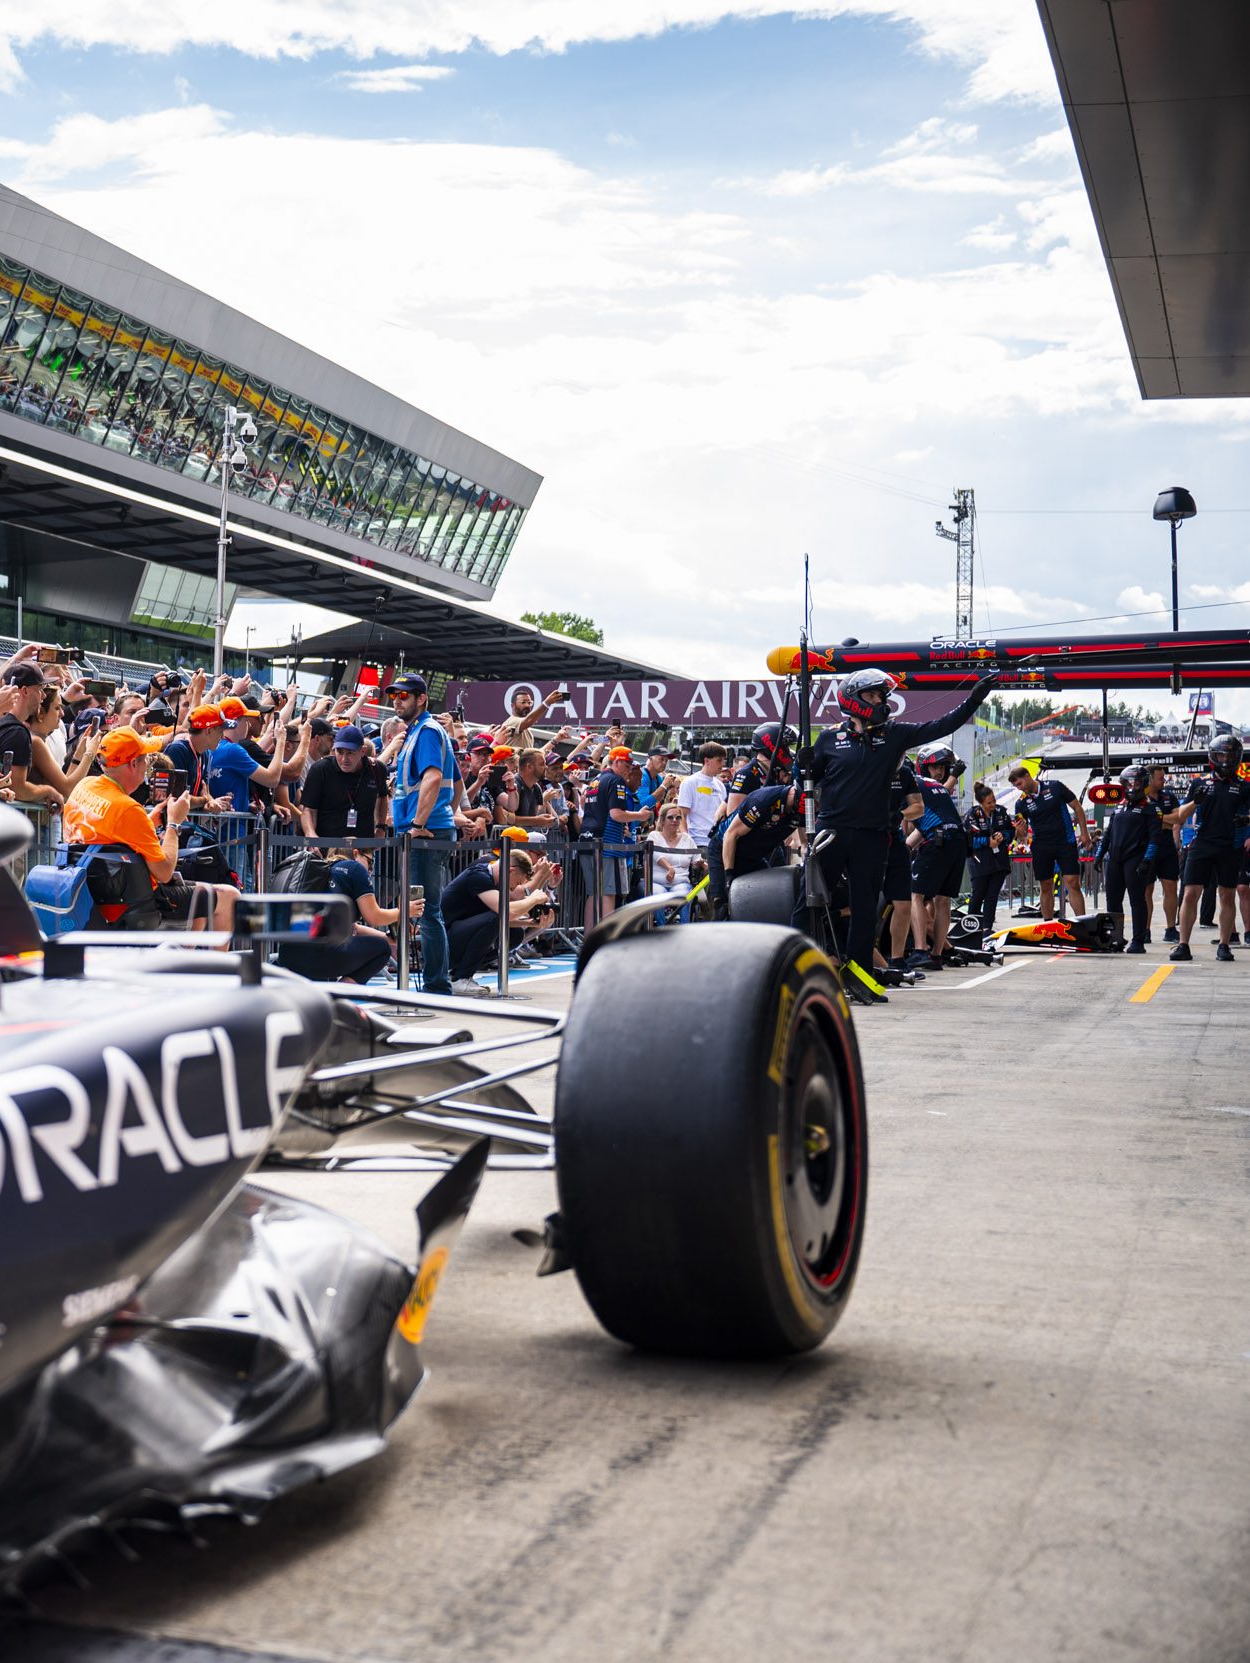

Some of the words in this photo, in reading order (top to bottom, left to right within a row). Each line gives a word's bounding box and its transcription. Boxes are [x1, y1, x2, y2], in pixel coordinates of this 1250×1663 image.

[929, 639, 997, 650] ORACLE
[929, 661, 998, 669] RACING
[504, 681, 668, 719] QATAR
[683, 680, 907, 719] AIRWAS
[851, 701, 873, 719] Bull
[1131, 757, 1174, 765] Einhell
[1168, 765, 1204, 773] Einhell
[964, 919, 978, 928] Esso
